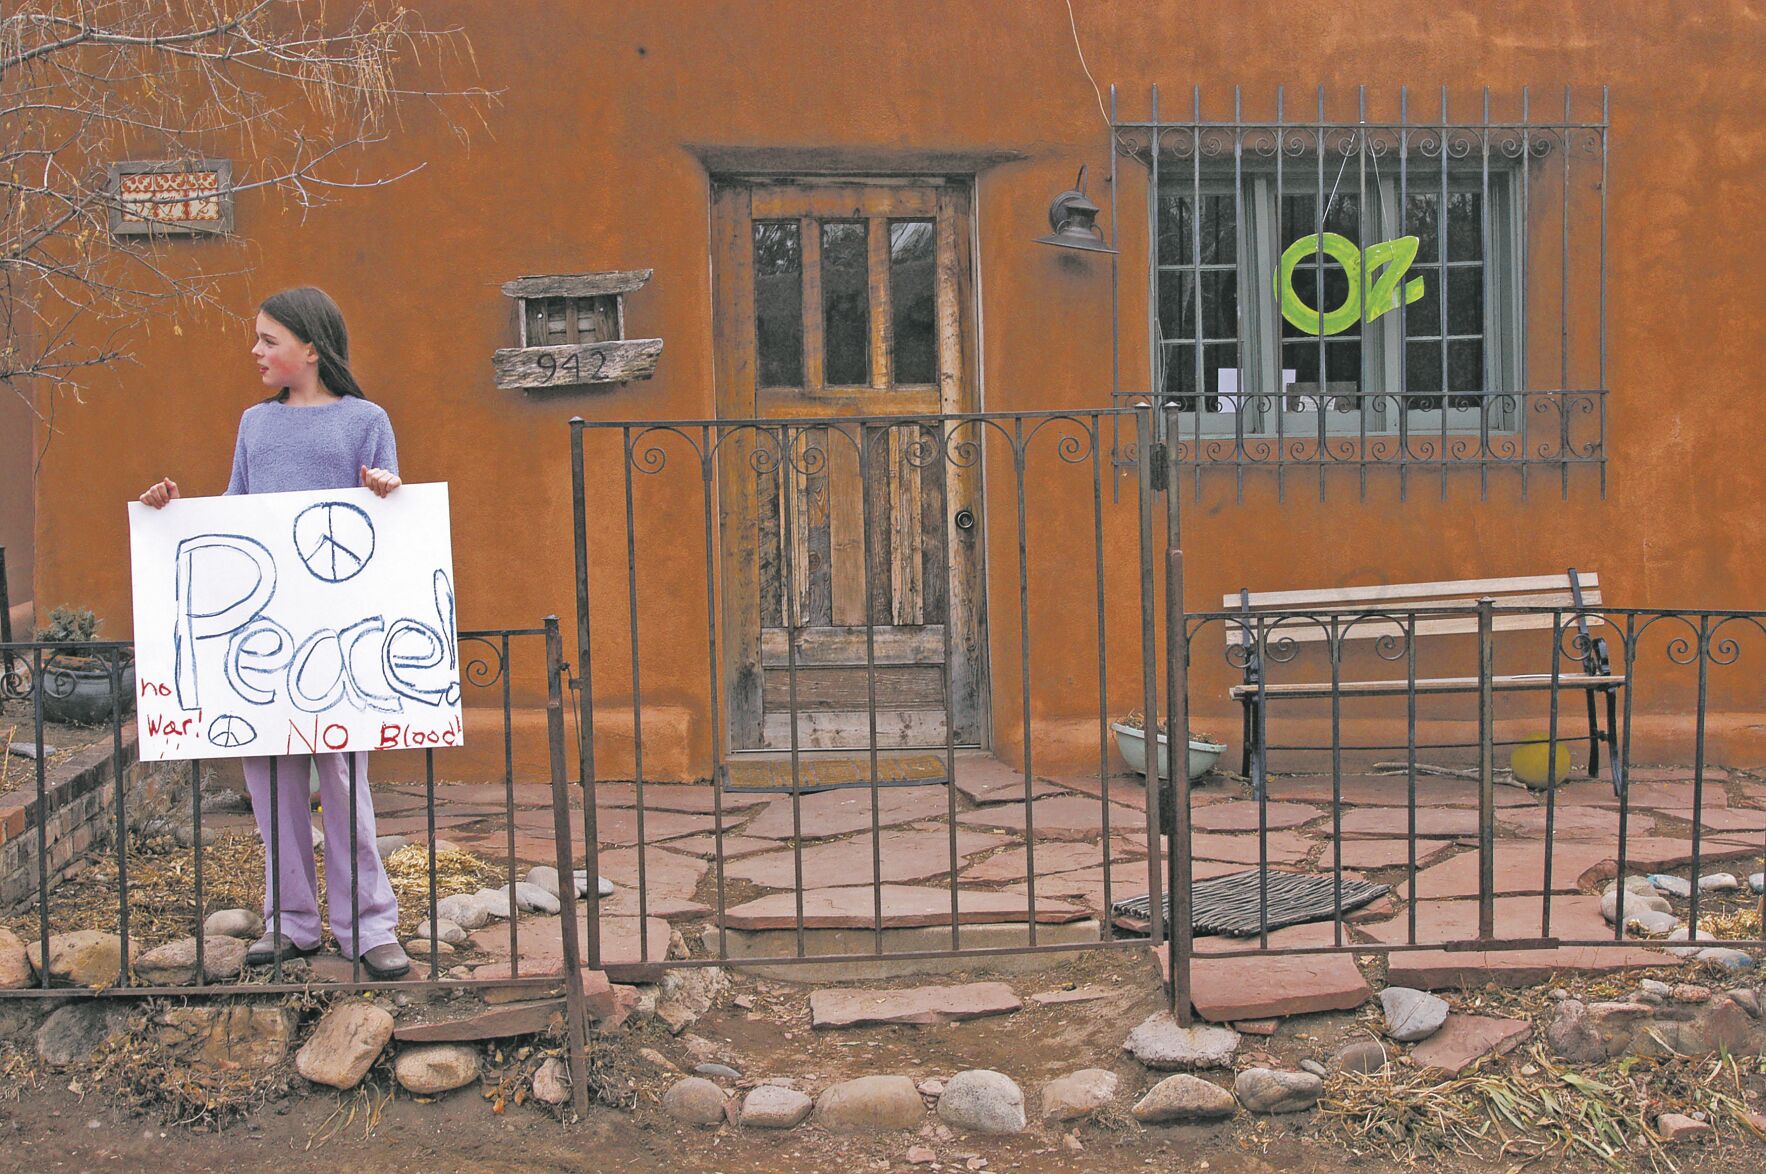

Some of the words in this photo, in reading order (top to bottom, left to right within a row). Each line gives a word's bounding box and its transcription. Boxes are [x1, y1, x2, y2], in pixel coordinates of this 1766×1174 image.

[537, 350, 609, 384] 942
[174, 533, 461, 713] Peace!
[141, 678, 172, 697] no
[147, 708, 202, 738] War!
[286, 714, 349, 756] NO
